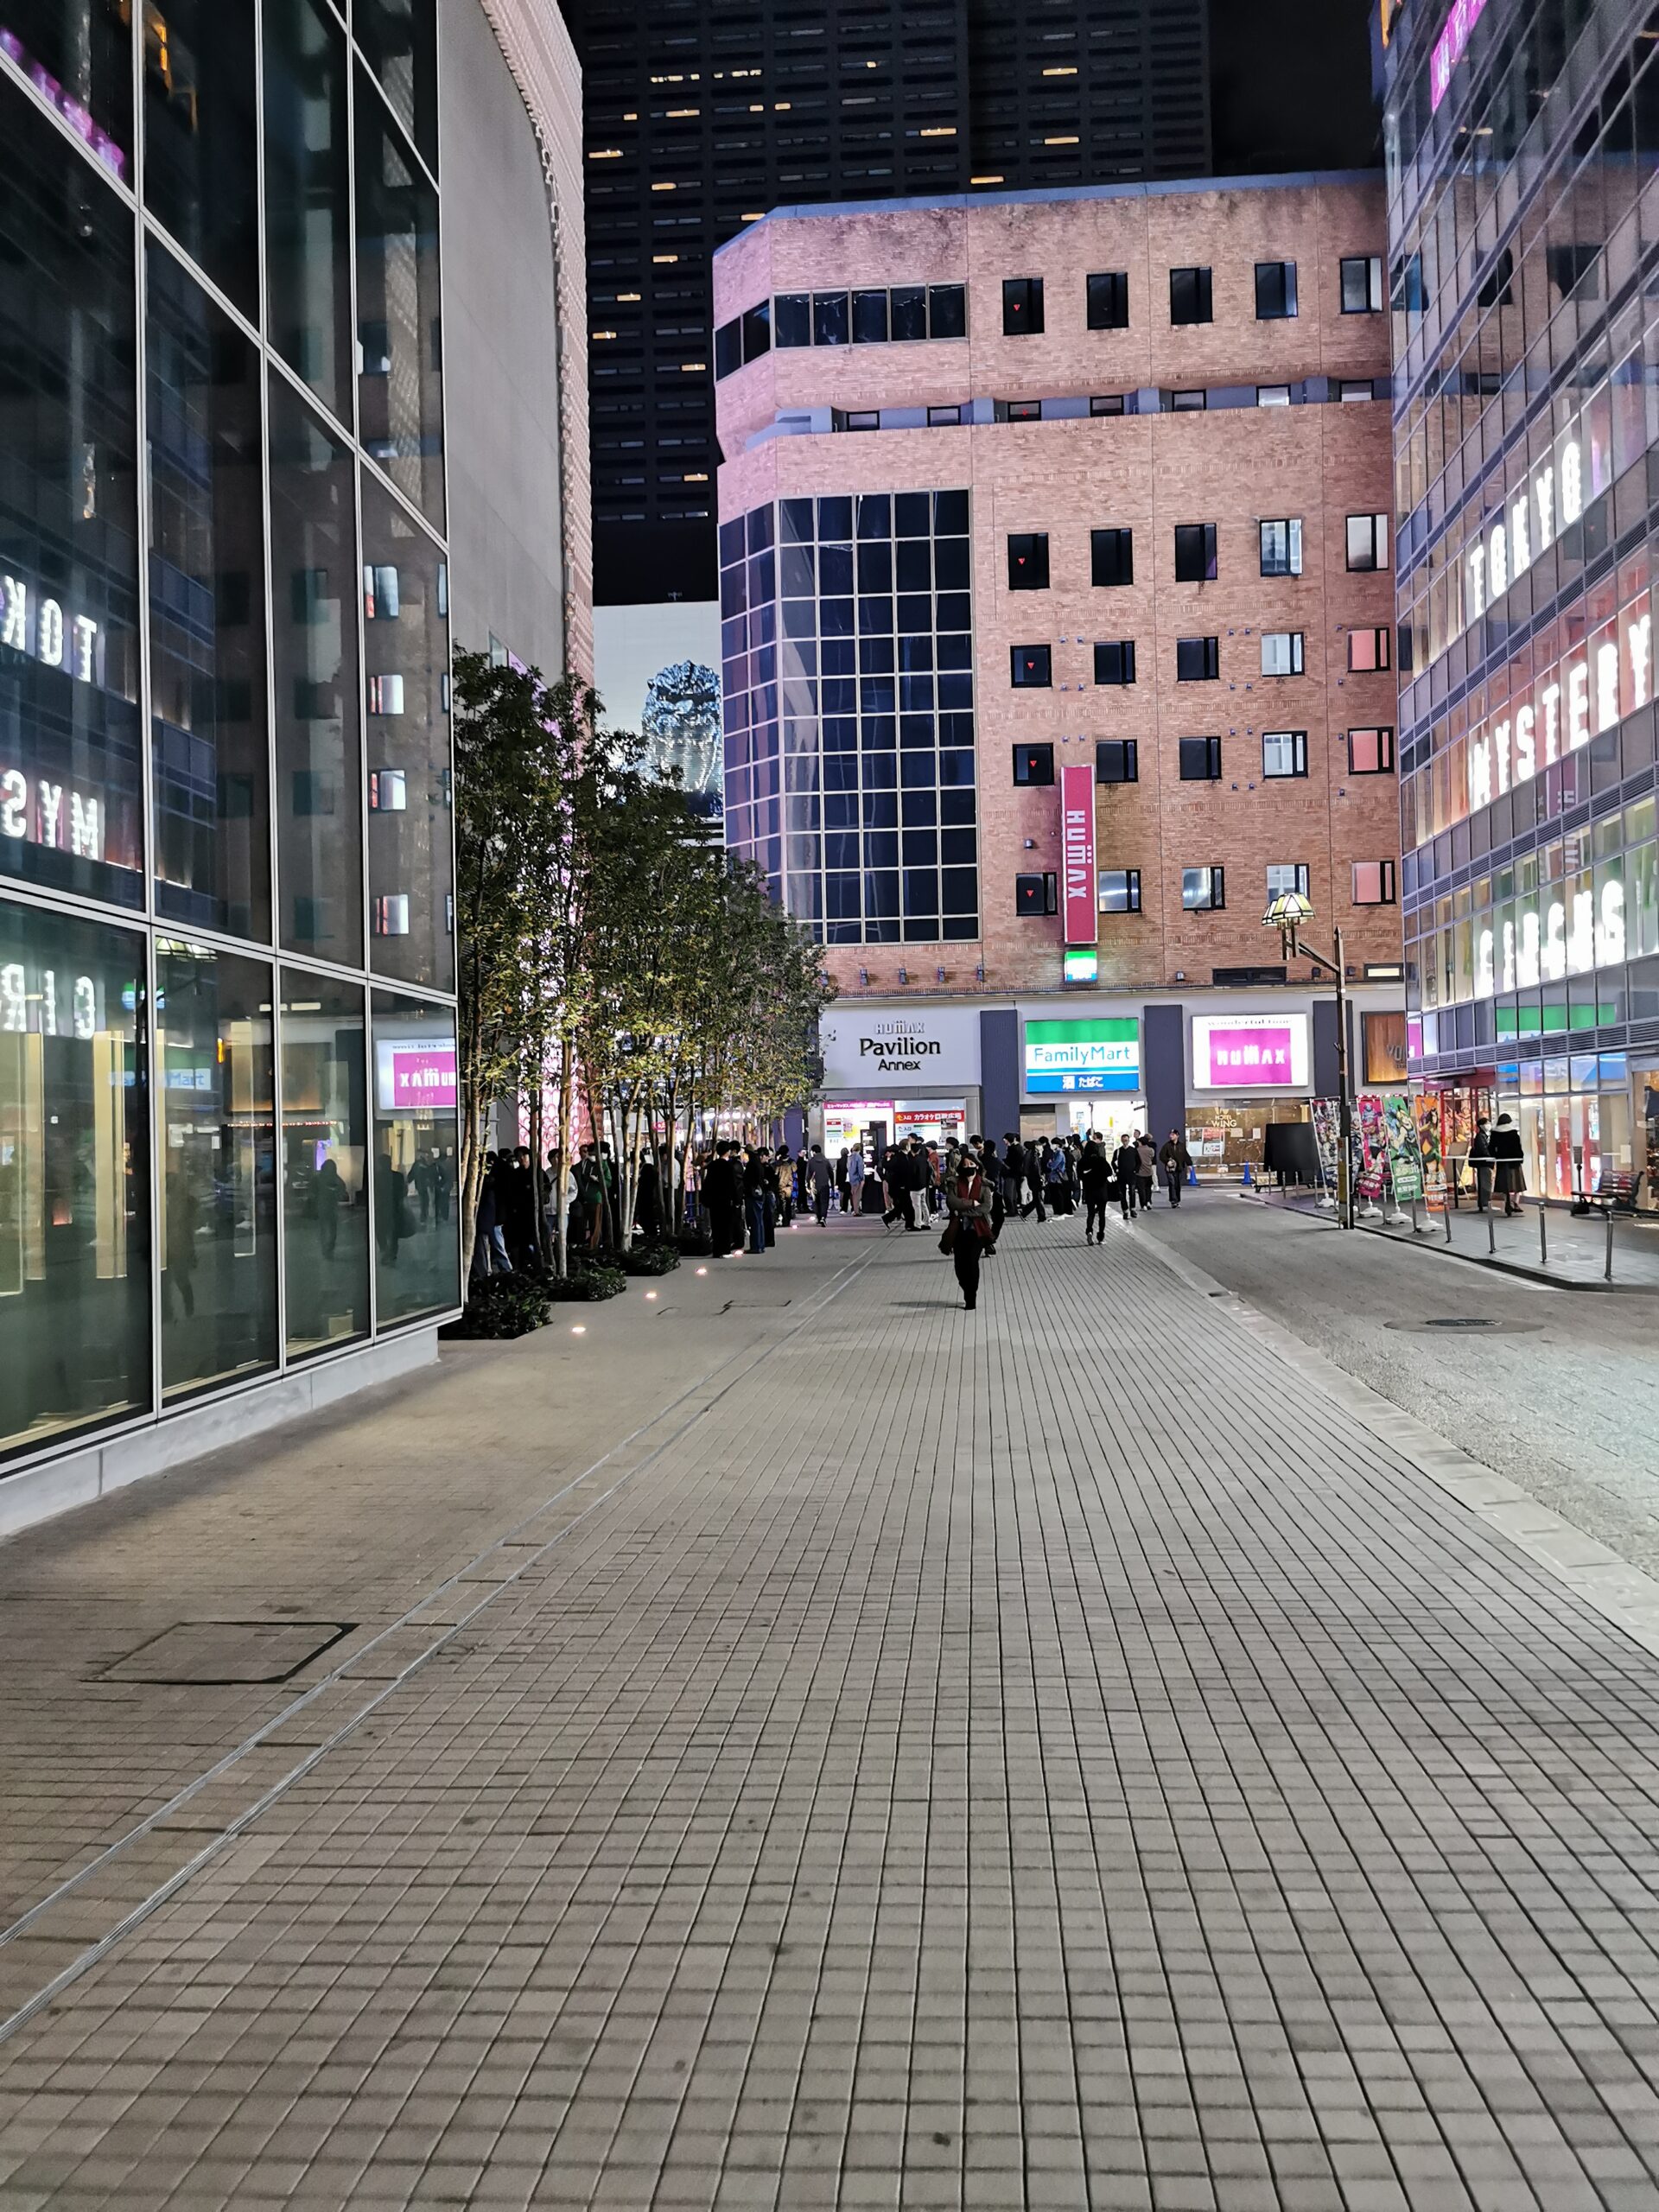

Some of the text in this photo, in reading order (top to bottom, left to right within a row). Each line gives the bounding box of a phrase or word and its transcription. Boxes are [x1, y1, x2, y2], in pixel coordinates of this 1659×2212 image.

[1470, 442, 1582, 620] TOKYO
[1472, 614, 1651, 813] MYSTERY
[860, 1037, 941, 1056] Pavilion
[1034, 1046, 1130, 1065] FamilyMart
[878, 1058, 921, 1071] Annex
